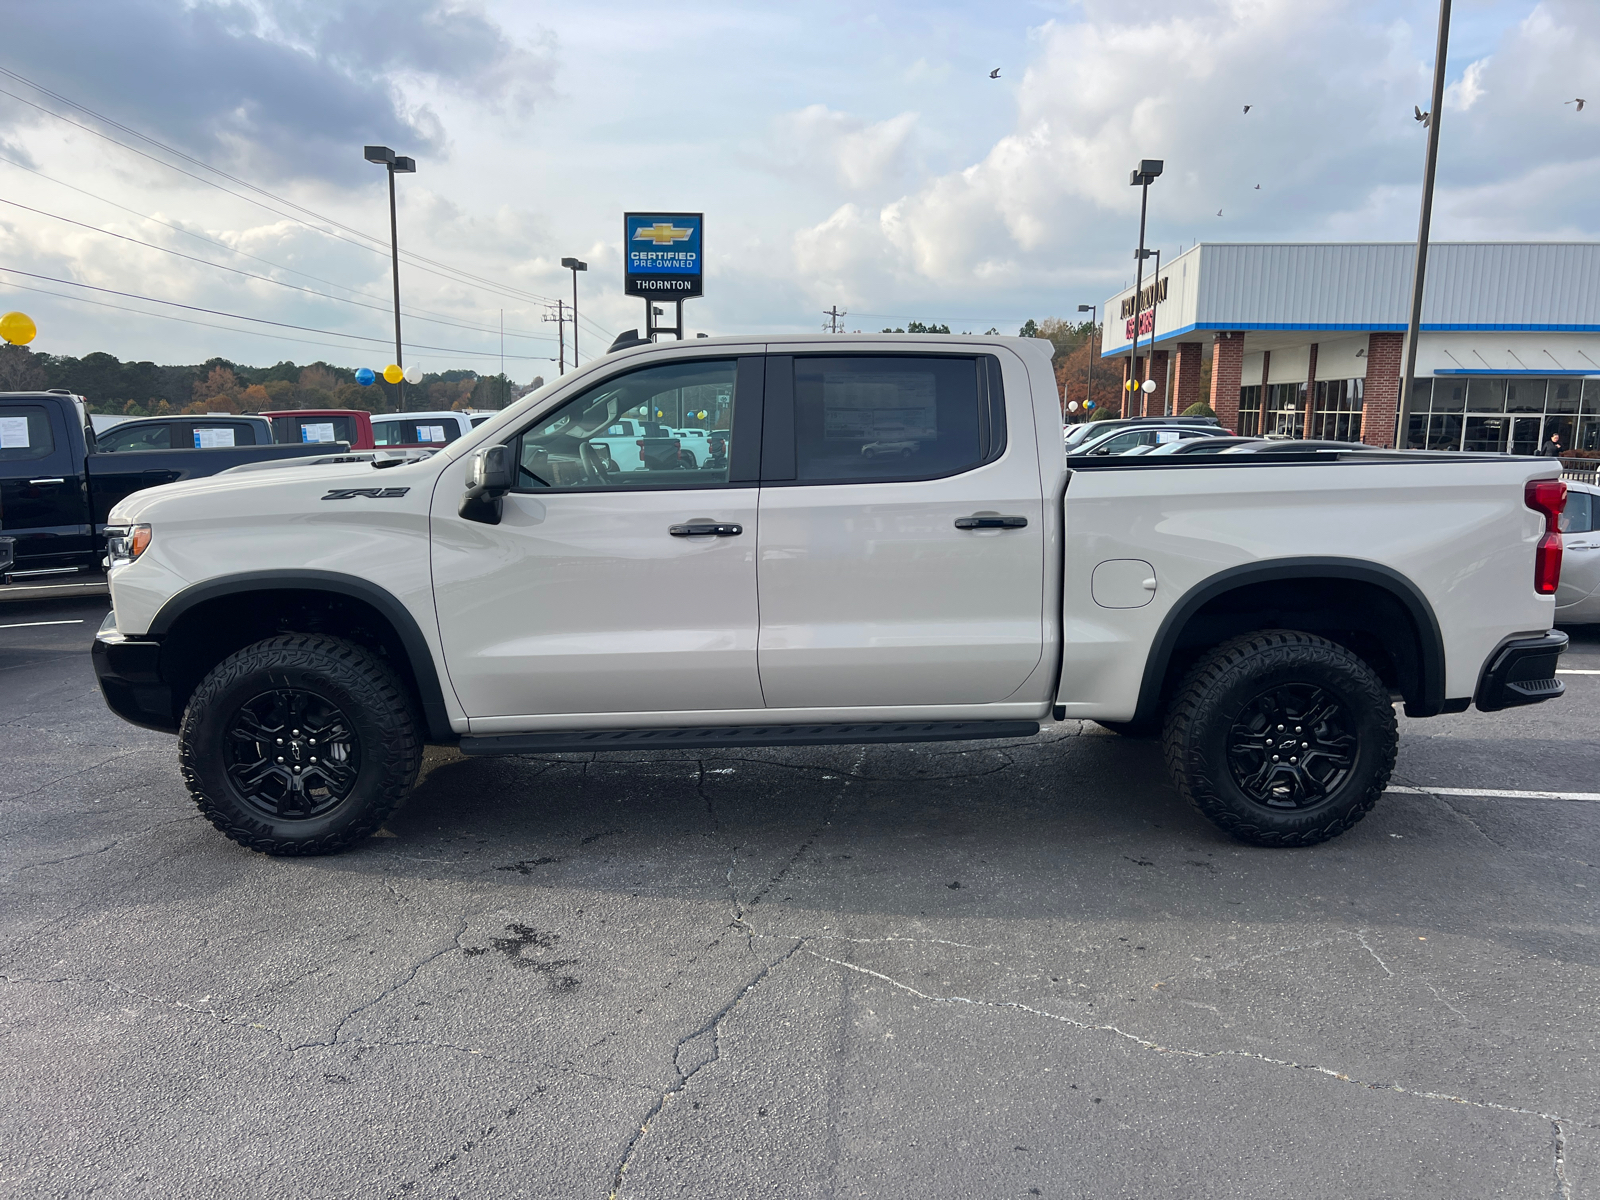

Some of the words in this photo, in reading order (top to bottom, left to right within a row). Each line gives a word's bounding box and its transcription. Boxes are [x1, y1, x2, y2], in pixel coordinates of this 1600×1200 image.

[630, 252, 696, 260] CERTIFIED
[633, 260, 693, 268] PRE-OWNED
[636, 280, 691, 290] THORNTON
[1135, 277, 1168, 312] ORNON
[321, 487, 411, 500] ZR2
